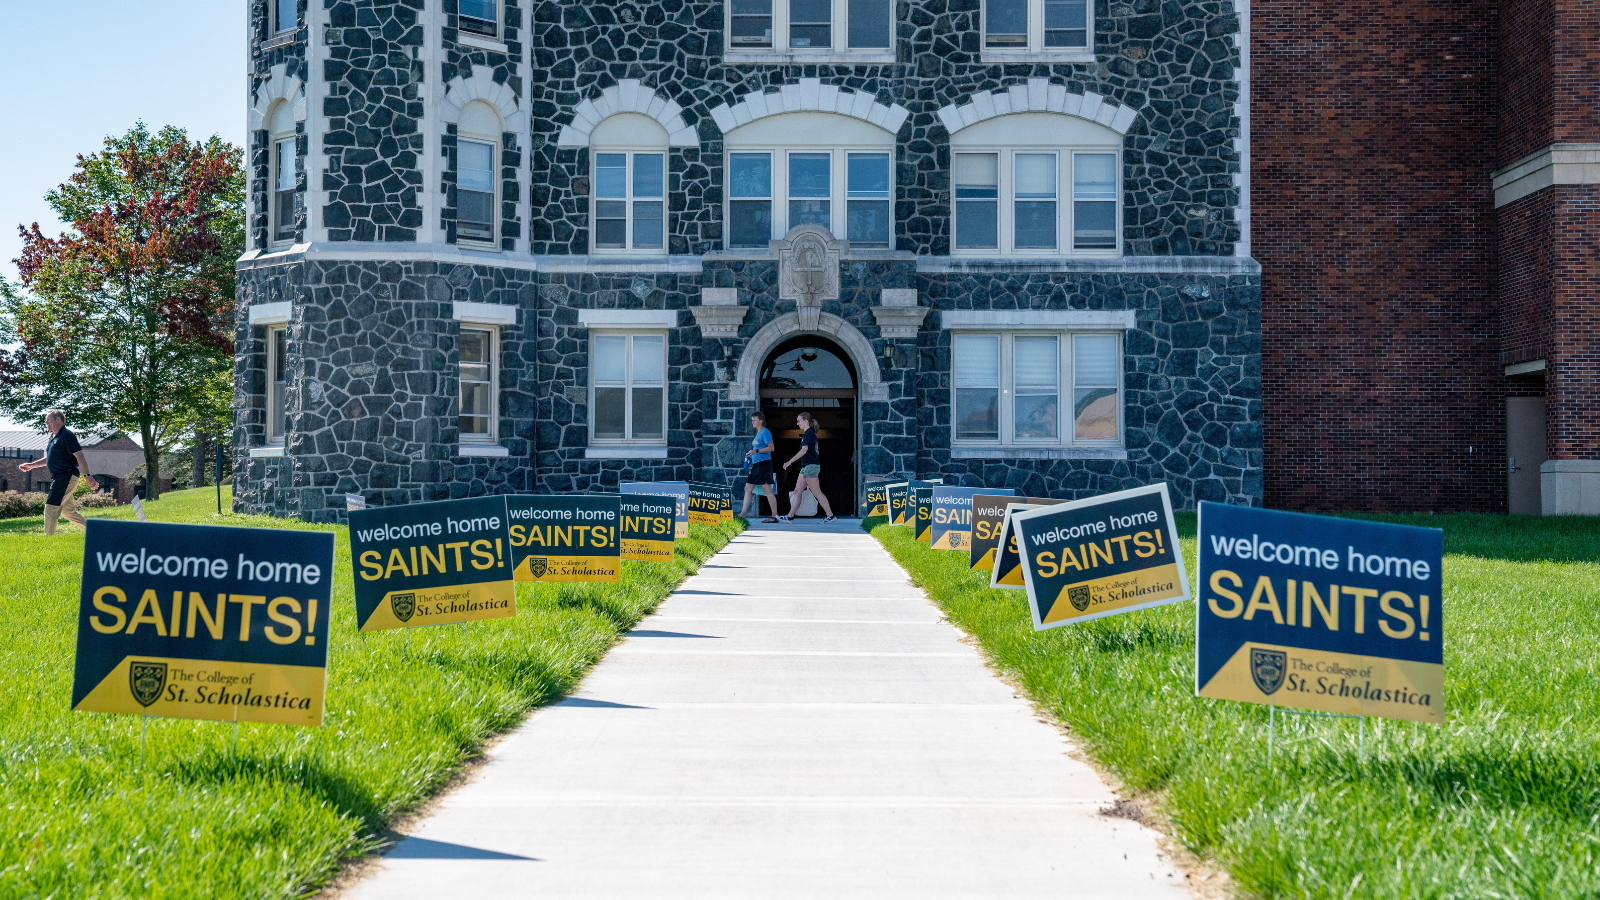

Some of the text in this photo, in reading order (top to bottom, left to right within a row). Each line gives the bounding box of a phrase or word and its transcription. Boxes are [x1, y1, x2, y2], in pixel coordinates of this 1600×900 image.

[642, 503, 672, 514] home
[688, 497, 720, 510] INTS!
[936, 496, 973, 505] welcom
[978, 506, 1006, 516] welc
[510, 507, 615, 520] welcome home
[357, 516, 500, 542] welcome home
[509, 524, 615, 547] SAINTS!
[621, 516, 671, 534] INTS!
[1032, 520, 1106, 546] welcome
[1110, 510, 1157, 530] home
[359, 538, 504, 581] SAINTS!
[1036, 529, 1165, 578] SAINTS!
[1210, 534, 1430, 580] welcome home
[96, 548, 320, 584] welcome home
[547, 567, 615, 576] St. Scholastica
[1091, 577, 1138, 593] The College of
[1092, 582, 1173, 605] St. Scholastica
[416, 598, 508, 616] St. Scholastica
[417, 590, 471, 603] The College of
[1208, 569, 1430, 641] SAINTS!
[89, 586, 318, 646] SAINTS!
[170, 669, 255, 685] The College of
[1290, 657, 1373, 678] The College of
[165, 684, 311, 710] St. Scholastica
[1287, 674, 1430, 706] St. Scholastica
